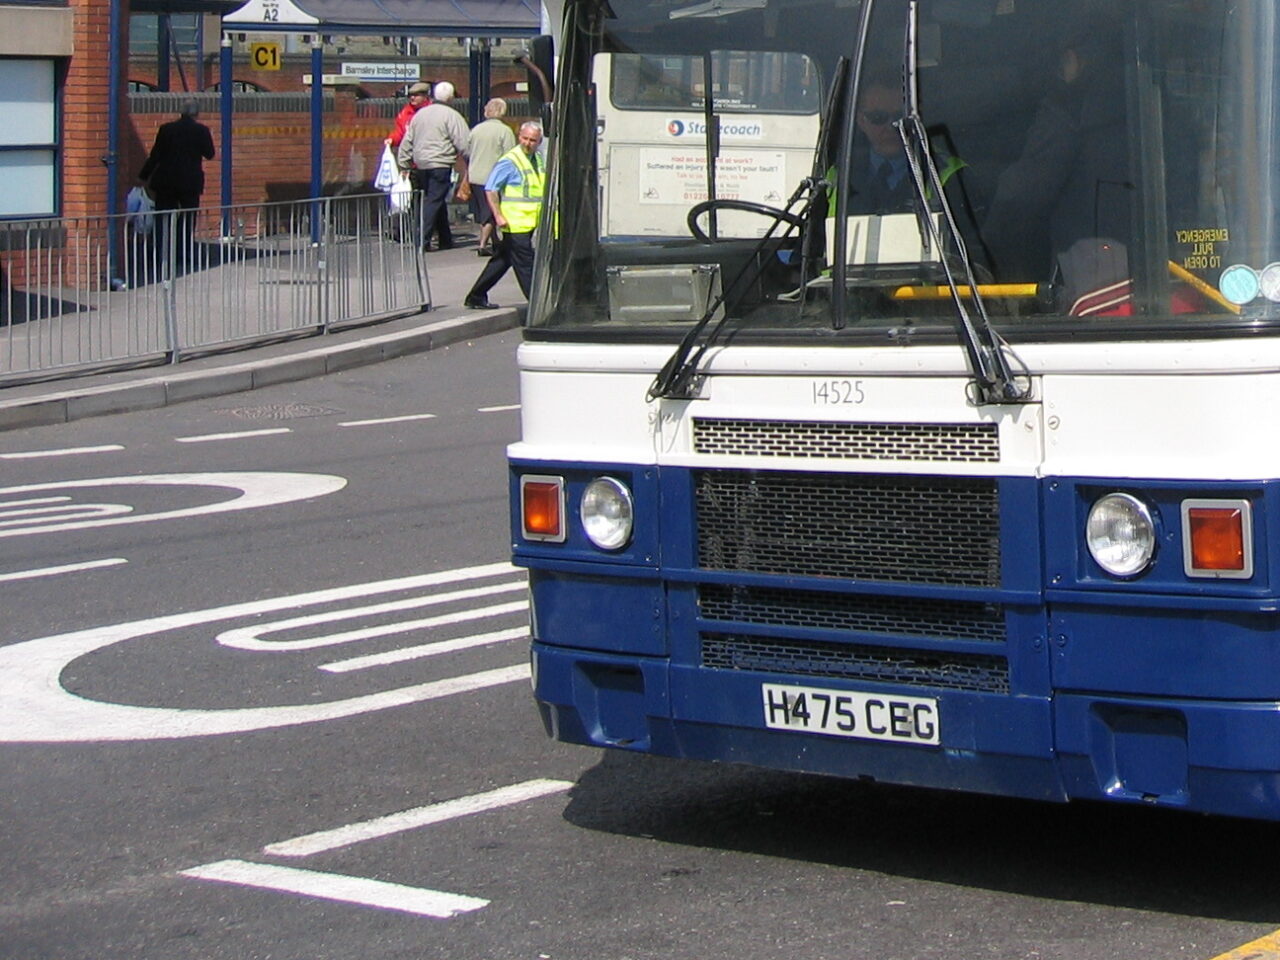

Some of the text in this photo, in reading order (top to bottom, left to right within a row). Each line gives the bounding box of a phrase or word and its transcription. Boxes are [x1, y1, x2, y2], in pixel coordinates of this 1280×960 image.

[263, 9, 279, 22] A2
[255, 46, 277, 67] C1
[345, 66, 417, 76] Barnsley Interchange
[687, 121, 761, 136] Staecoach
[812, 380, 865, 405] 14525
[767, 689, 935, 740] H475 CEG
